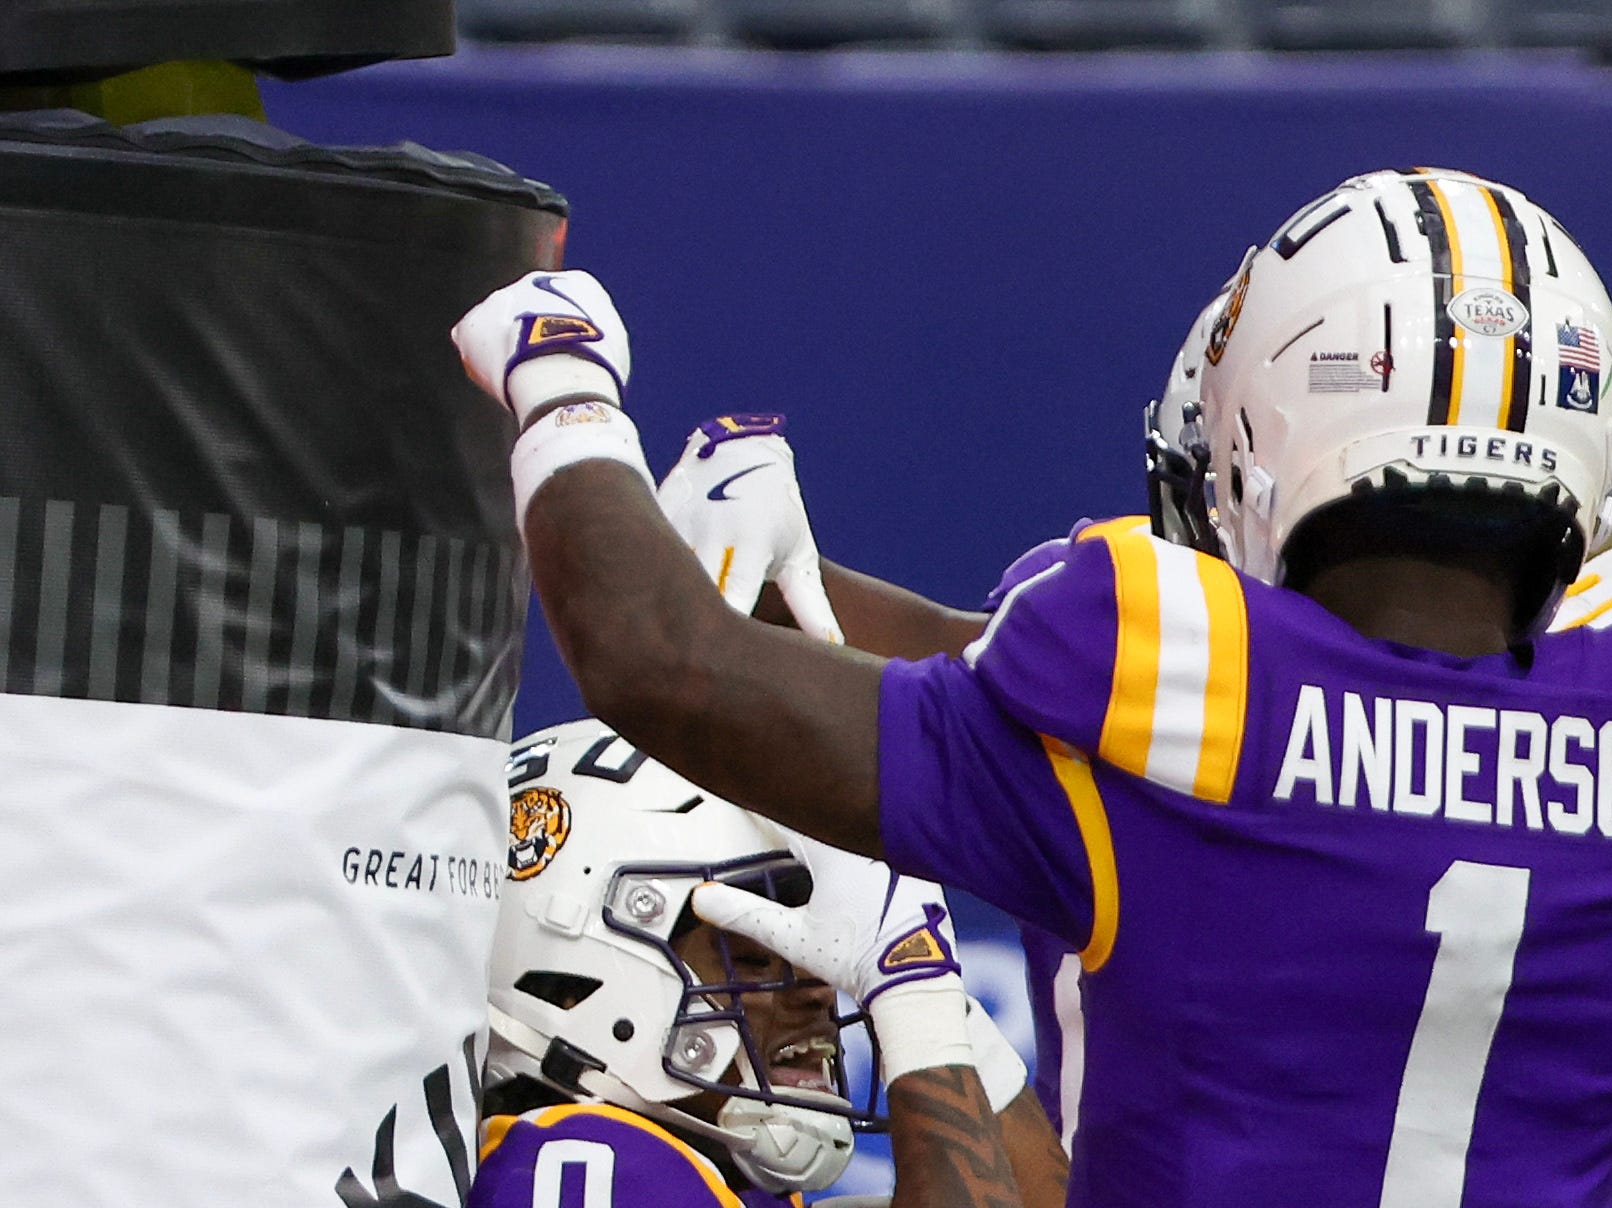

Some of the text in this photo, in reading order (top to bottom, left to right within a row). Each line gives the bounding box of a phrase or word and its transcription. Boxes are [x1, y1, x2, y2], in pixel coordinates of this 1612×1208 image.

[1464, 303, 1515, 323] TEXAS
[1319, 352, 1359, 361] DANGER
[1410, 434, 1557, 472] TIGERS
[343, 846, 440, 892] GREAT
[447, 855, 478, 897] FOR
